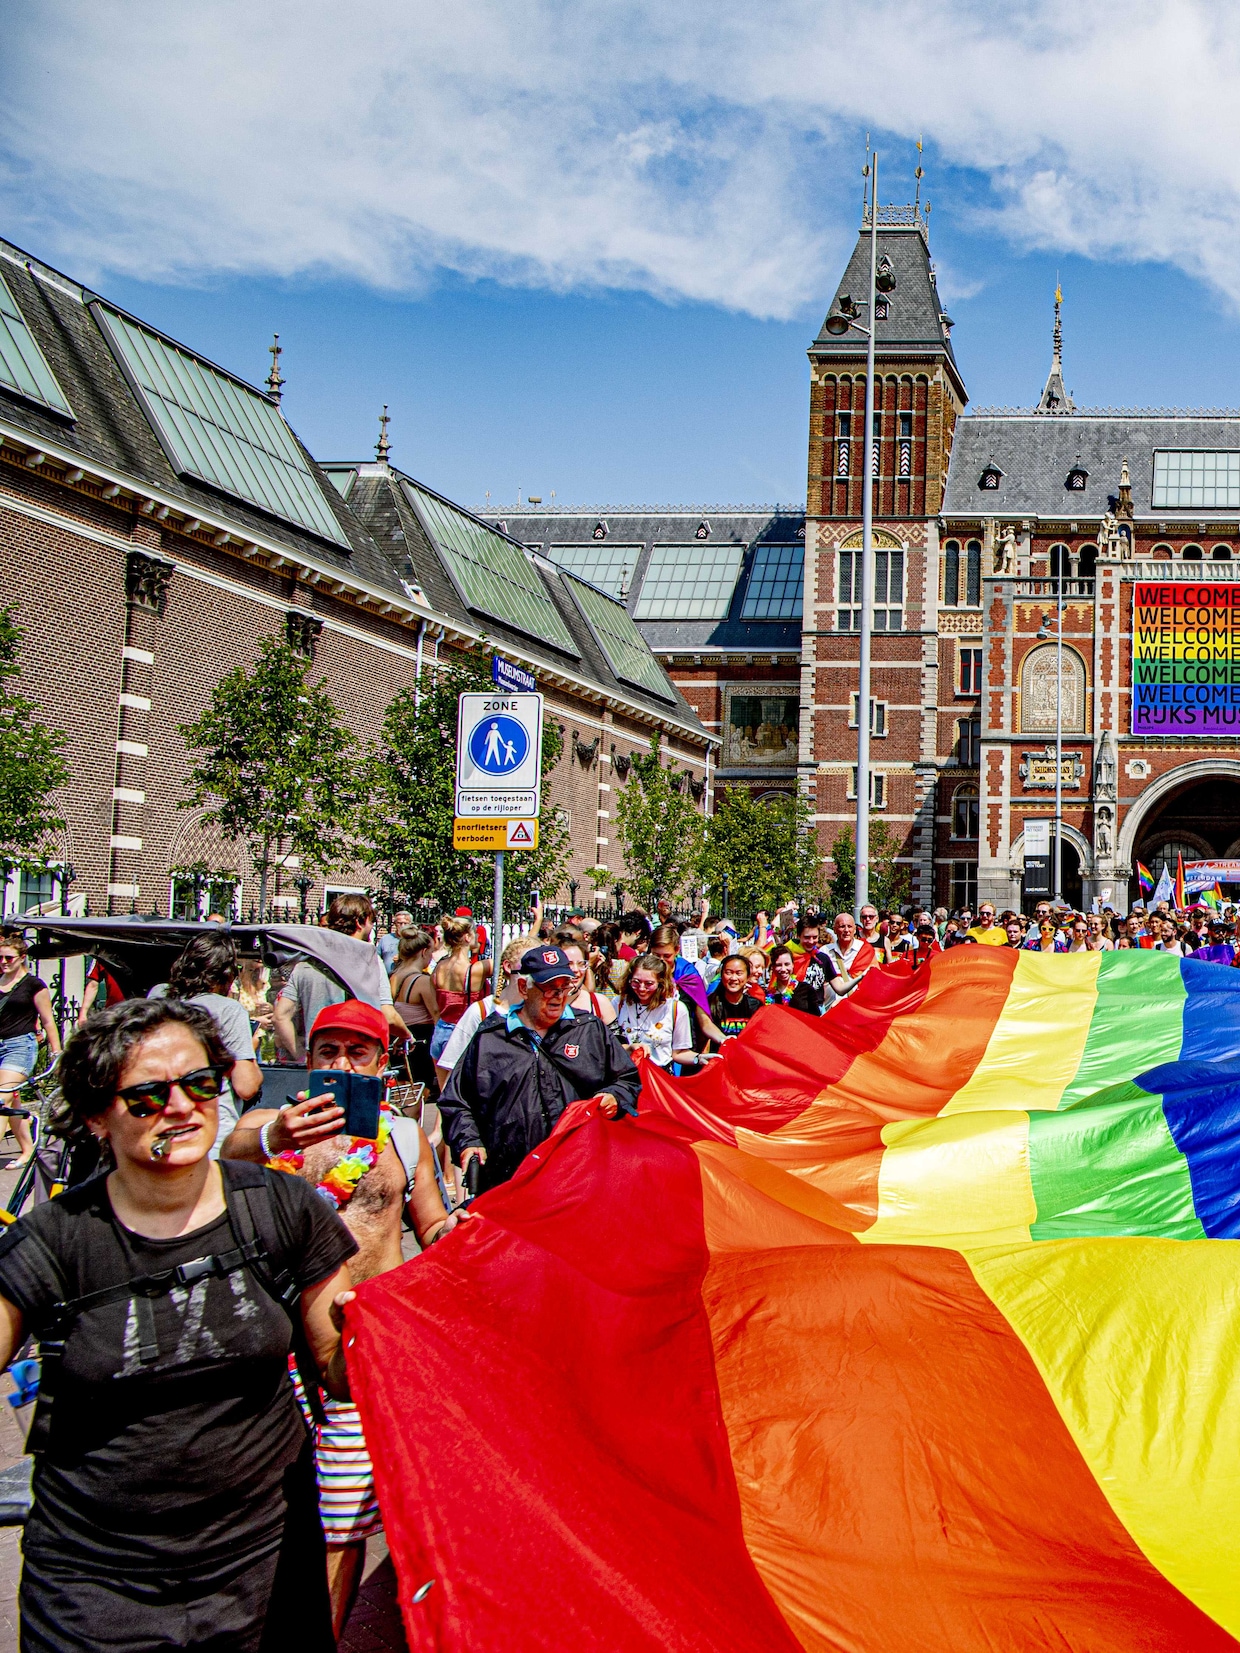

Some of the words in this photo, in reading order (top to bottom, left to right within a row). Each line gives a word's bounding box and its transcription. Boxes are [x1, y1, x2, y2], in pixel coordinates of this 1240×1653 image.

[497, 660, 535, 690] MUSEUMSTRAAT
[483, 701, 518, 711] ZONE
[1137, 704, 1197, 724] RIJKS
[491, 795, 533, 804] toegestaan
[494, 804, 522, 812] rijloper
